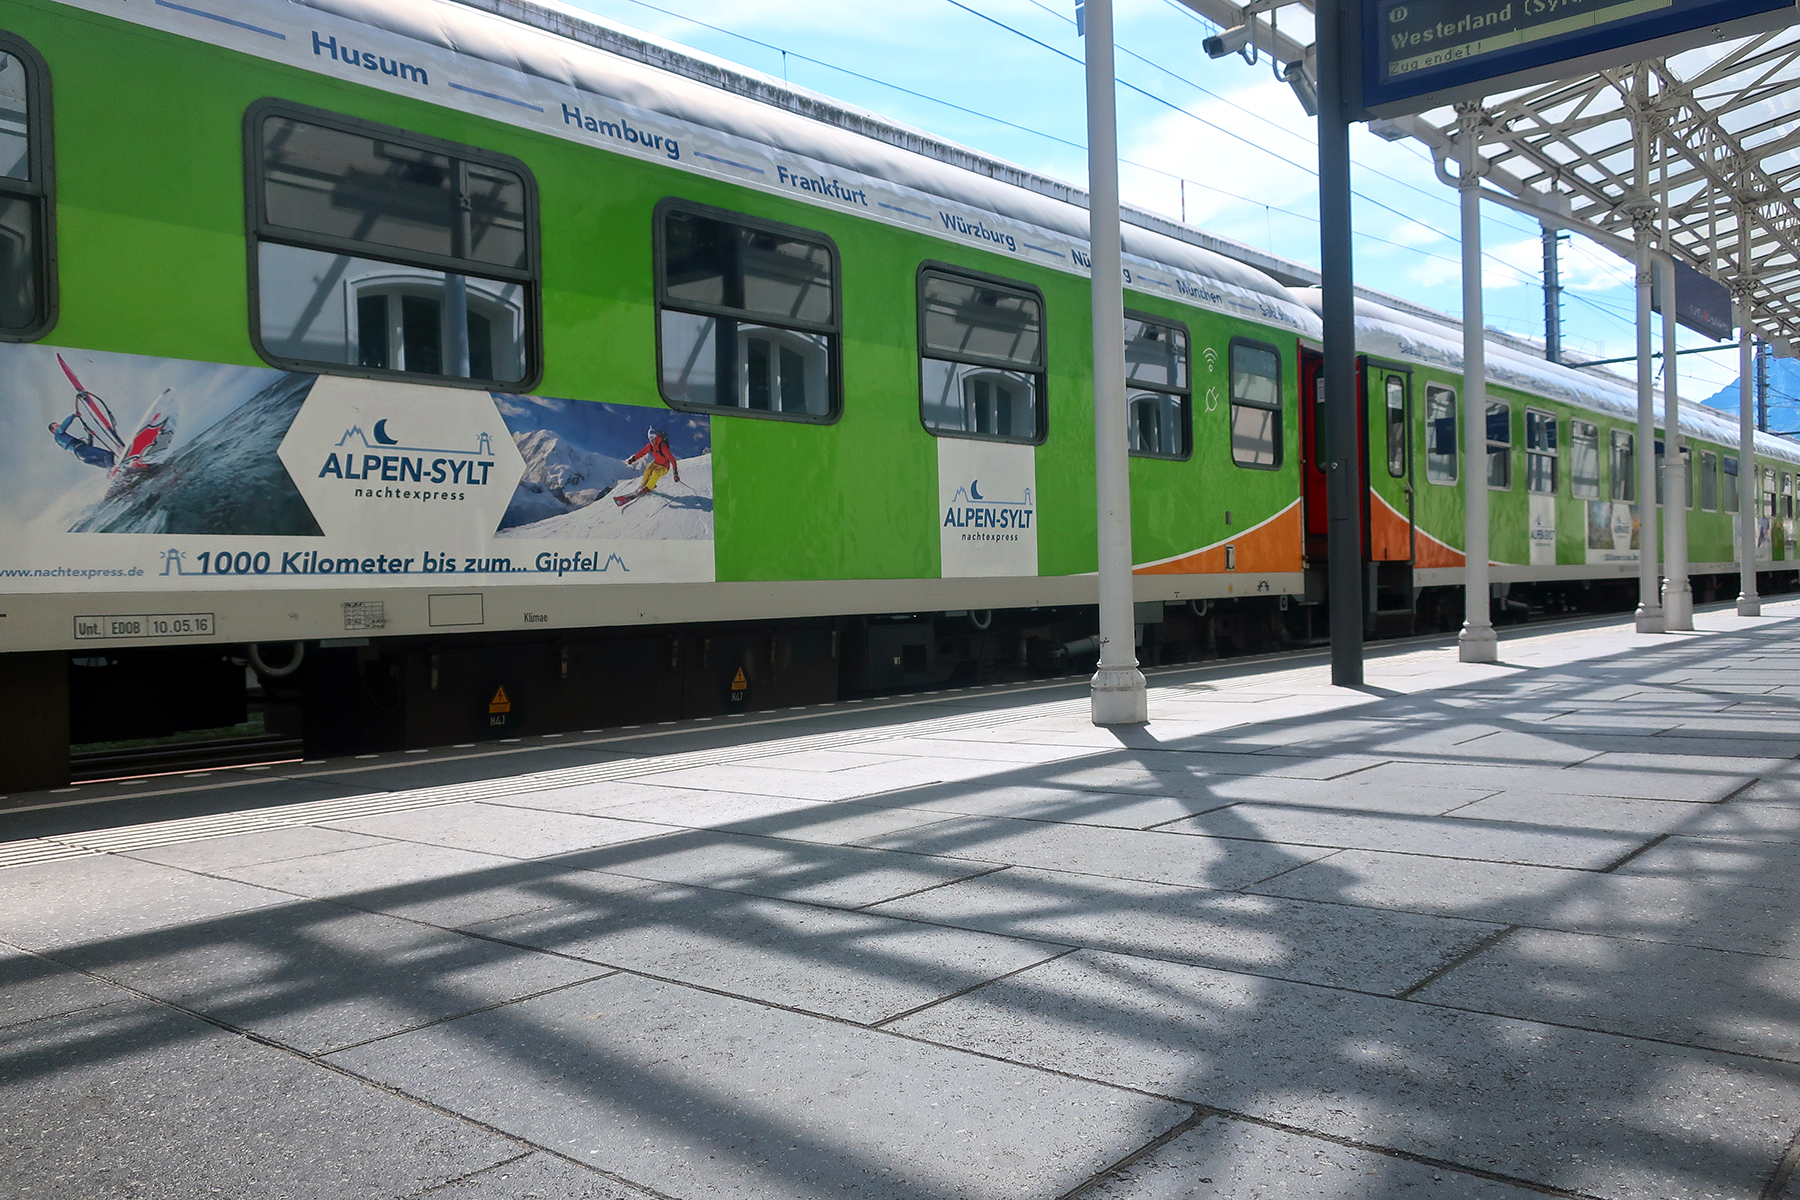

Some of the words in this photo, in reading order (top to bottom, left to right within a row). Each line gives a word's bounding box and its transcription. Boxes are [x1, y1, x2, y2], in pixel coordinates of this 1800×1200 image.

[1391, 3, 1512, 50] Westerland
[1524, 0, 1582, 16] (Sy
[311, 30, 429, 85] Husum
[1390, 61, 1419, 76] Zug
[561, 102, 680, 161] Hamburg
[776, 164, 868, 207] Frankfurt
[939, 210, 1017, 252] Würzburg
[1176, 279, 1223, 304] München
[318, 452, 495, 486] ALPEN-SYLT
[354, 486, 465, 503] nachtexpress
[943, 507, 1034, 529] ALPEN-SYLT
[961, 531, 1019, 543] nachtexpress
[196, 551, 271, 575] 1000
[280, 550, 414, 575] Kilometer
[422, 551, 456, 574] bis
[464, 556, 527, 573] zum...
[535, 551, 598, 577] Gipfel
[153, 618, 209, 634] 10.05.16
